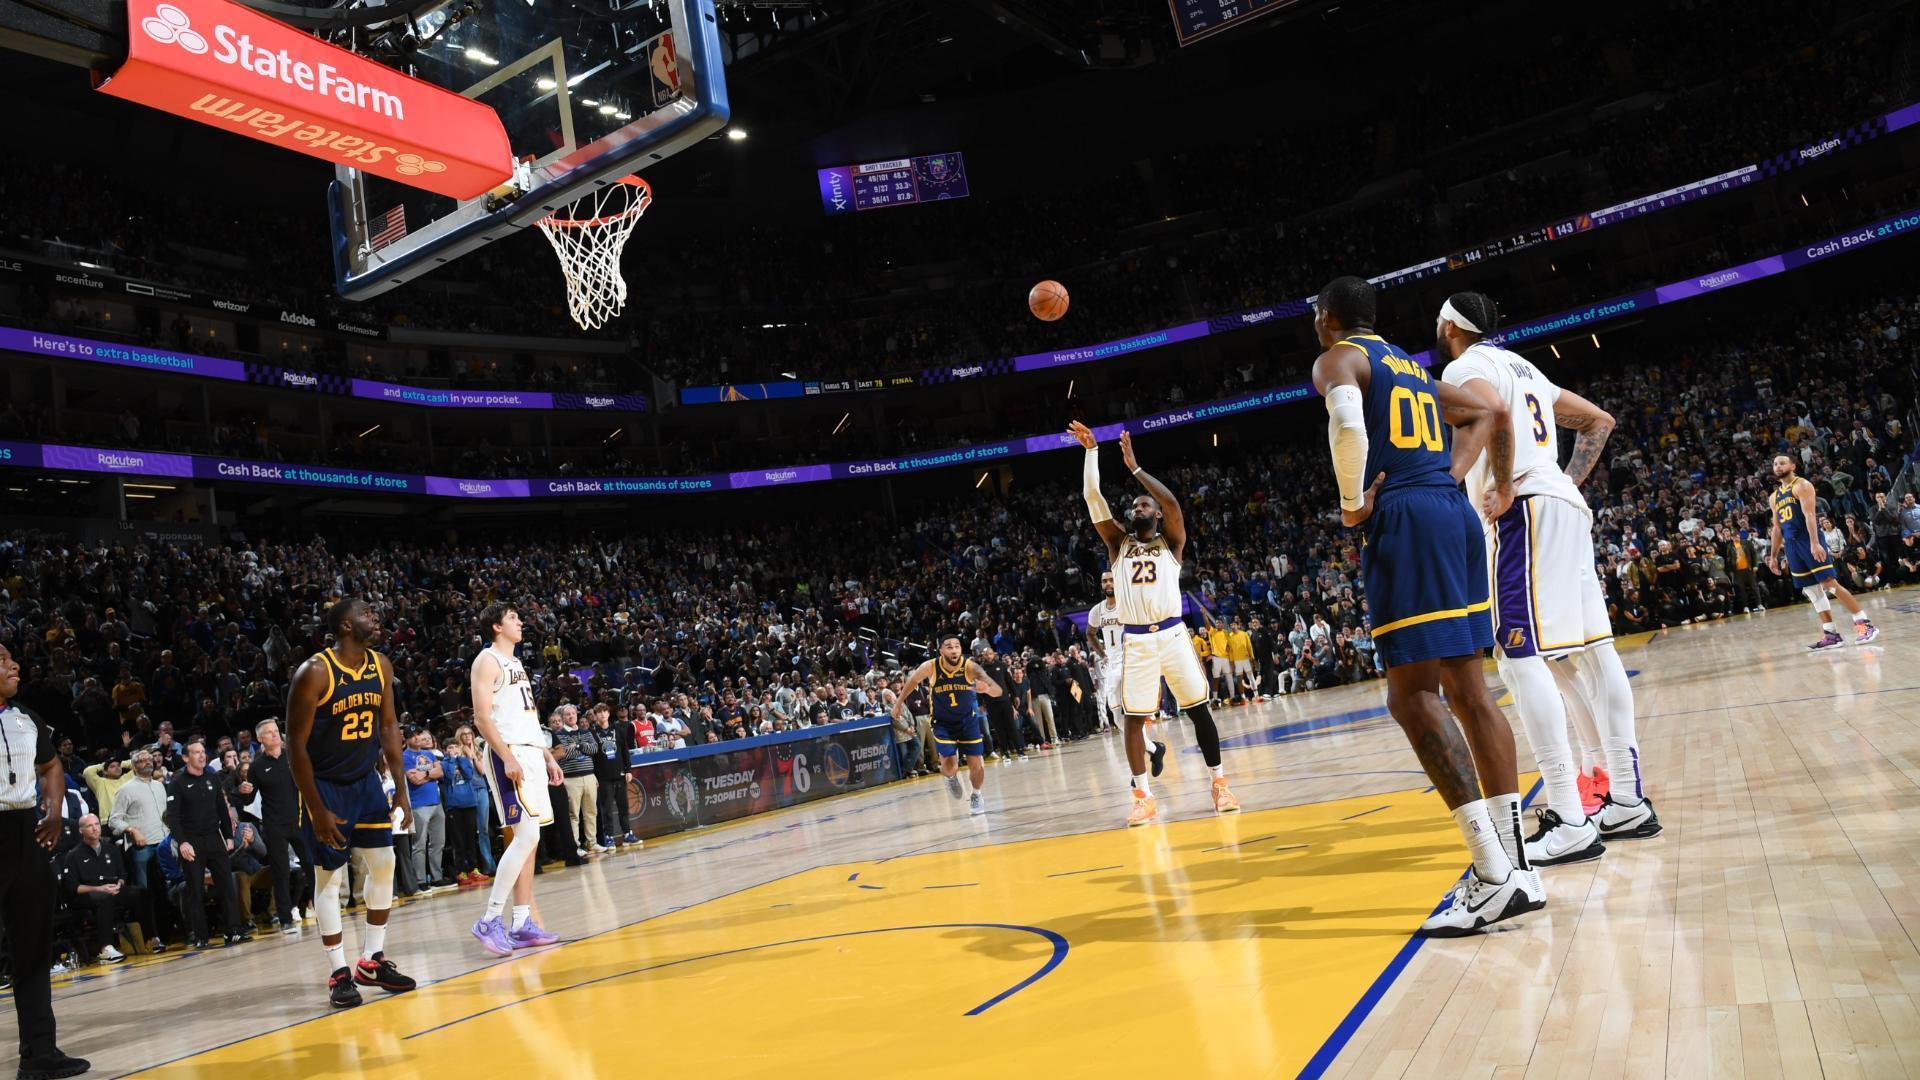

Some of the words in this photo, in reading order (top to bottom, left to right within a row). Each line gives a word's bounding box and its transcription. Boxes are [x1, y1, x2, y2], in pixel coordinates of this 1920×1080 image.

[1222, 6, 1239, 20] 39.7
[1800, 137, 1841, 159] Rakuten
[828, 171, 847, 211] xfinity
[1555, 222, 1574, 236] 143
[1511, 235, 1525, 247] 1.2
[1807, 240, 1840, 258] Cash
[1841, 229, 1876, 248] Back
[1877, 222, 1893, 236] at
[1464, 250, 1481, 263] 144
[56, 272, 104, 289] accenture
[1699, 270, 1739, 288] Rakuten
[213, 299, 248, 313] verizon
[280, 311, 316, 327] Adobe
[1242, 309, 1274, 323] Rakuten
[1507, 331, 1521, 341] at
[1521, 313, 1582, 338] thousands
[1583, 307, 1596, 320] of
[1597, 299, 1636, 317] stores
[337, 321, 380, 337] ticketmaster
[33, 336, 76, 353] Here's
[78, 343, 93, 355] to
[95, 347, 129, 360] extra
[132, 350, 194, 369] basketball
[1054, 351, 1083, 362] Here's
[1083, 349, 1094, 358] to
[1095, 345, 1119, 357] extra
[1119, 332, 1168, 350] basketball
[283, 371, 318, 385] Rakuten
[891, 376, 914, 385] FINAL
[952, 365, 983, 378] Rakuten
[383, 387, 400, 398] and
[402, 390, 426, 401] extra
[426, 392, 448, 403] cash
[450, 392, 460, 403] in
[462, 395, 484, 405] your
[486, 394, 523, 406] pocket.
[585, 396, 615, 407] Rakuten
[1143, 416, 1168, 430] Cash
[1169, 410, 1194, 424] Back
[1195, 408, 1207, 418] at
[1207, 397, 1261, 415] thousands
[1262, 394, 1274, 404] of
[1275, 387, 1309, 401] stores
[1389, 385, 1444, 452] 00
[1524, 391, 1551, 447] 3
[98, 453, 144, 468] Rakuten
[848, 464, 873, 474] Cash
[874, 461, 897, 472] Back
[898, 460, 910, 470] at
[910, 452, 963, 467] thousands
[964, 450, 976, 460] of
[977, 445, 1009, 457] stores
[217, 462, 250, 477] Cash
[251, 464, 282, 479] Back
[284, 468, 297, 480] at
[299, 469, 359, 485] thousands
[360, 474, 373, 485] of
[374, 476, 407, 488] stores
[765, 470, 797, 482] Rakuten
[459, 482, 491, 493] Rakuten
[549, 482, 575, 493] Cash
[576, 481, 601, 492] Back
[603, 482, 615, 491] at
[615, 480, 667, 491] thousands
[668, 479, 679, 489] of
[679, 479, 712, 489] stores
[1779, 505, 1793, 523] 30
[1131, 560, 1157, 585] 23
[1109, 629, 1117, 648] 1
[332, 692, 363, 716] GOLDEN
[948, 692, 959, 708] 1
[341, 710, 374, 741] 23
[851, 743, 889, 761] TUESDAY
[873, 760, 882, 769] ET
[704, 769, 755, 791] TUESDAY
[650, 794, 661, 807] VS
[704, 790, 736, 807] 7:30PM
[736, 788, 748, 799] ET
